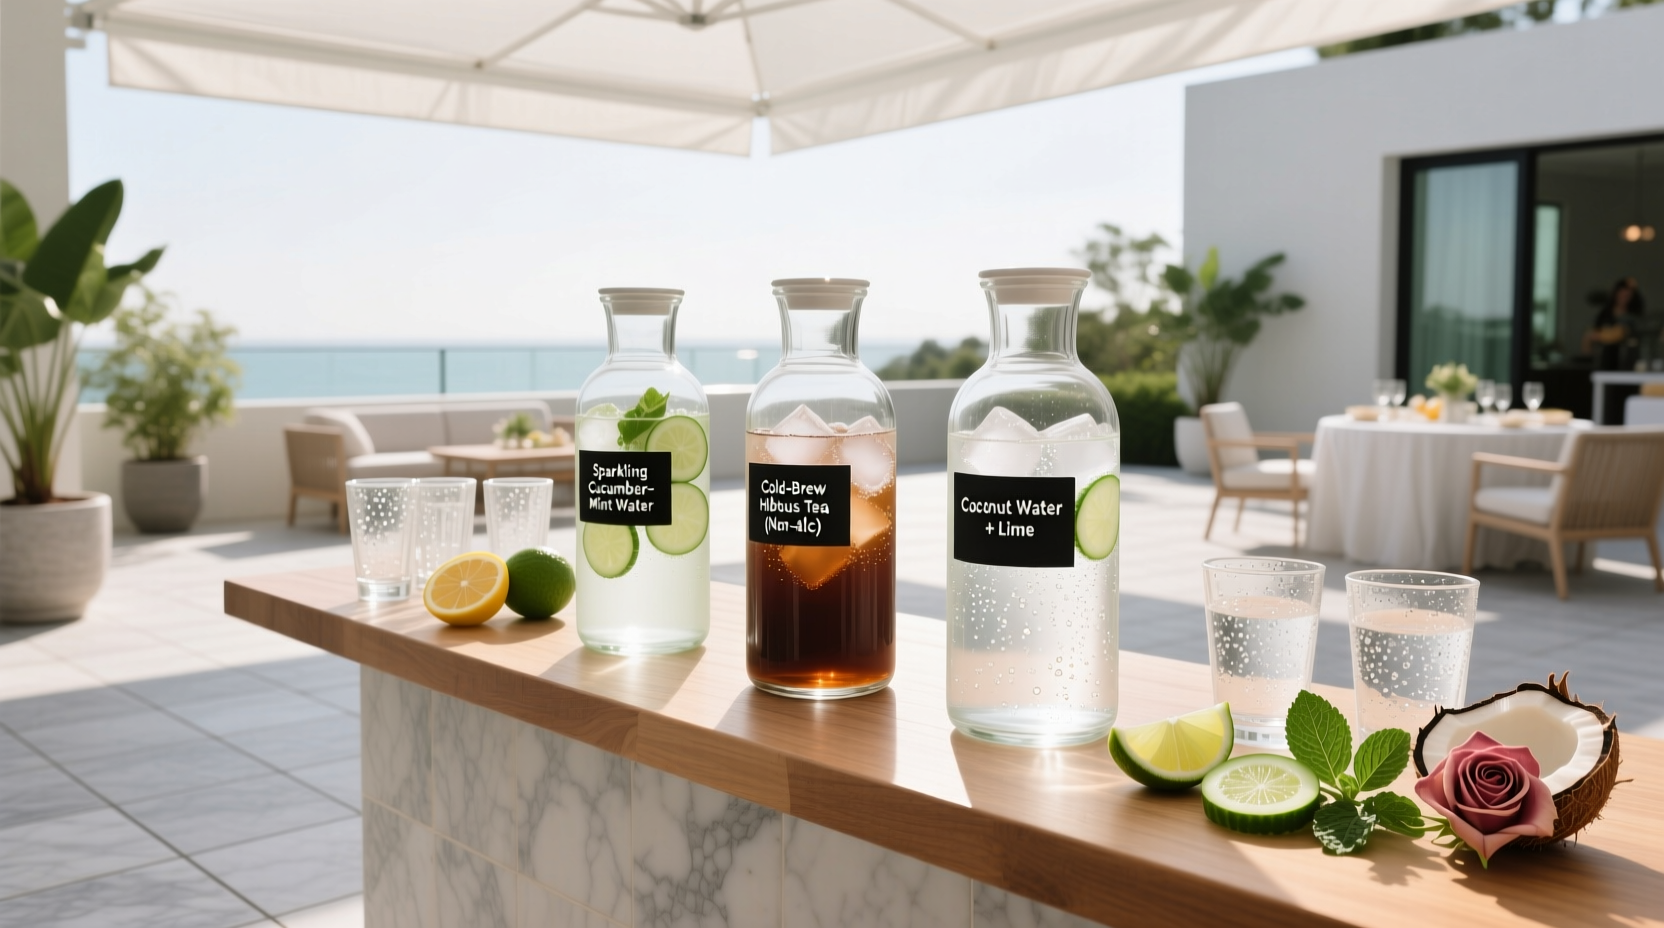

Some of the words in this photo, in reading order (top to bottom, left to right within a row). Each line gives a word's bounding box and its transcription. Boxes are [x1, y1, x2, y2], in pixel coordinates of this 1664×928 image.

[592, 463, 648, 481] Sparkling
[761, 479, 827, 496] Cold-Brew
[589, 497, 613, 511] Mint
[615, 498, 654, 512] Water
[803, 499, 830, 515] Tea
[961, 496, 1013, 515] Coconut
[1016, 499, 1063, 516] Water
[985, 521, 995, 535] +
[998, 520, 1035, 537] Lime
